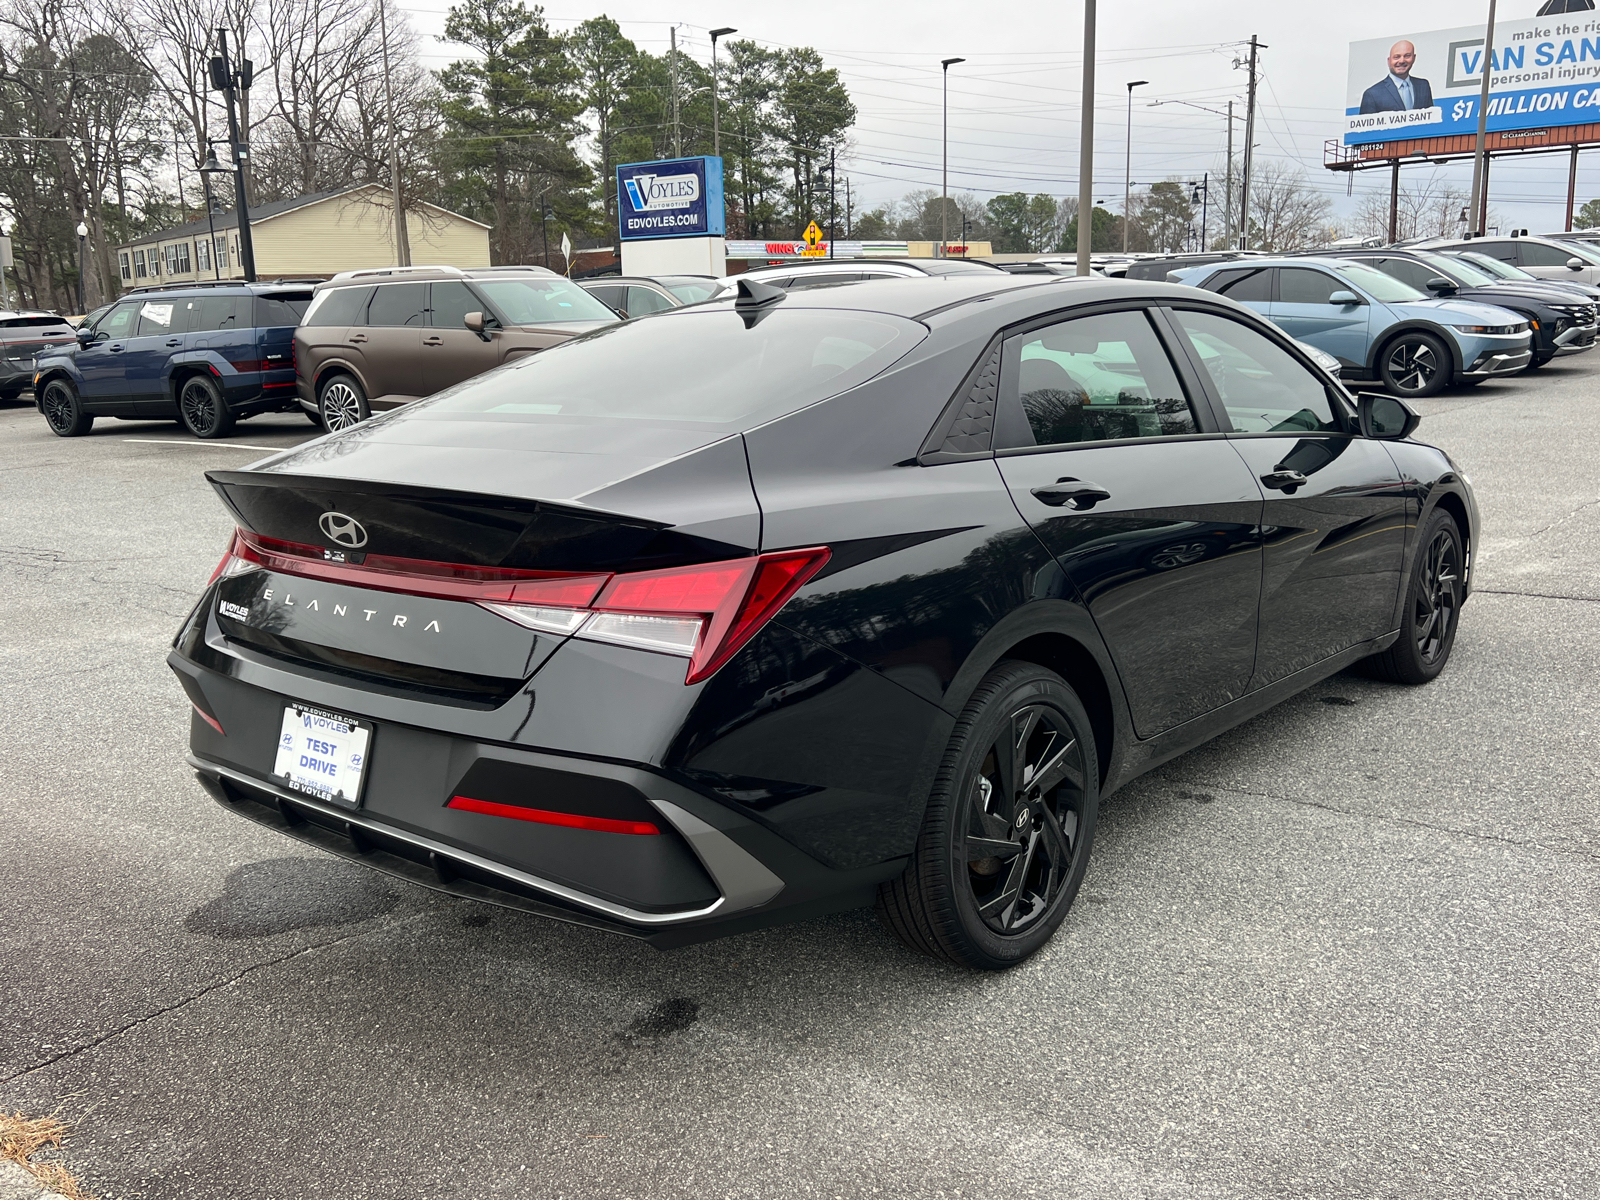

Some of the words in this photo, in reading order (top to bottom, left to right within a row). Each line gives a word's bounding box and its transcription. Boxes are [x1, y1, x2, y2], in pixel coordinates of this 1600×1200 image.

[1512, 27, 1551, 41] make
[1556, 23, 1580, 36] the
[1461, 45, 1525, 75] VAN
[1534, 36, 1600, 66] SAN
[1491, 67, 1554, 88] personal
[1558, 64, 1600, 80] injury
[1451, 98, 1475, 122] $1
[1477, 91, 1569, 118] MILLION
[1350, 119, 1375, 129] DAVID
[1376, 117, 1387, 126] M.
[1389, 114, 1407, 124] VAN
[1408, 111, 1433, 122] SANT
[635, 176, 694, 206] VOYLES
[649, 201, 689, 209] AUTOMOTIVE
[628, 214, 698, 230] EDVOYLES.COM
[765, 243, 794, 254] WING
[263, 588, 440, 633] ELANTRA
[292, 703, 359, 726] WWW.EDVOYLES.COM
[313, 716, 348, 734] VOYLES
[306, 737, 337, 756] TEST
[300, 755, 337, 777] DRIVE
[289, 780, 300, 790] ED
[301, 784, 332, 801] VOYLES
